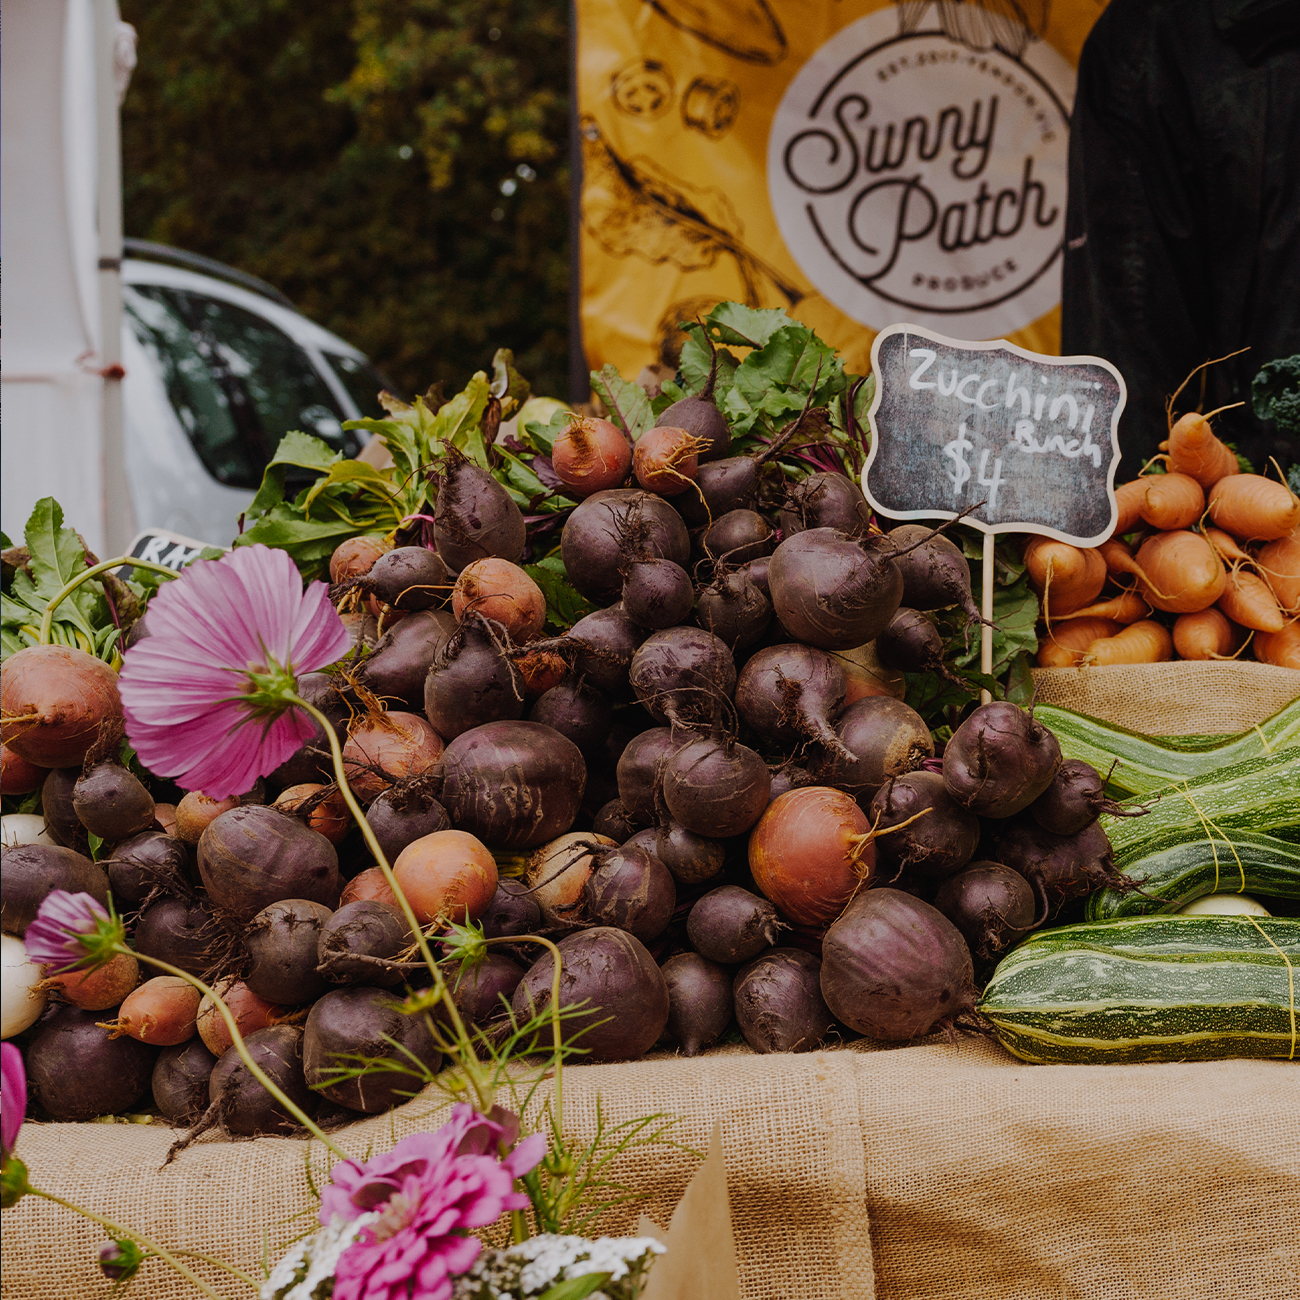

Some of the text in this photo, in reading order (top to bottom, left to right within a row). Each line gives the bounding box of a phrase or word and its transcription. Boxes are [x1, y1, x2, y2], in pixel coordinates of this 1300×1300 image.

[782, 93, 999, 195] Sunny
[847, 154, 1059, 283] Patch
[911, 257, 1018, 293] PRODUCE
[908, 348, 1102, 433] Zucchini
[943, 422, 1006, 522] $4
[1014, 419, 1101, 468] Bunch
